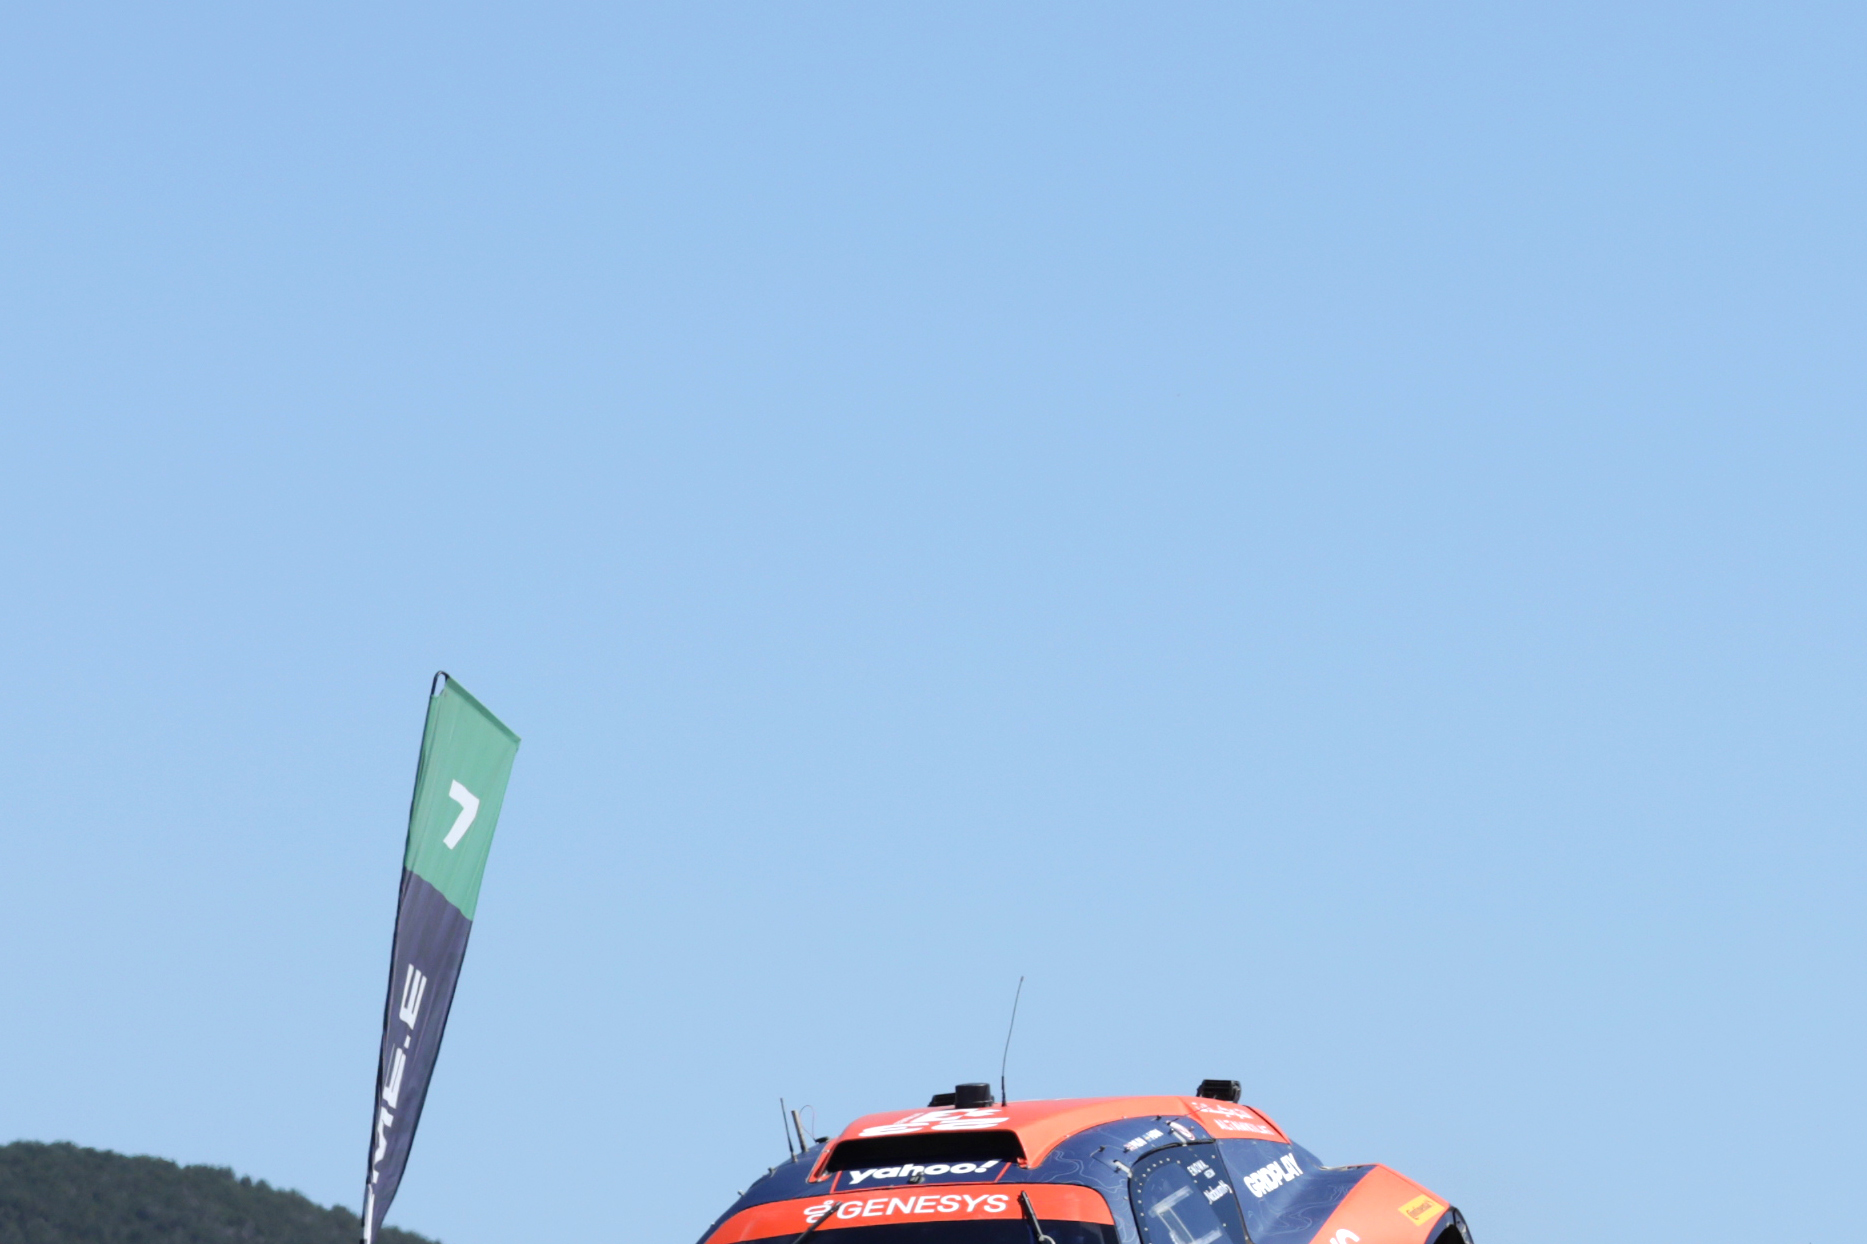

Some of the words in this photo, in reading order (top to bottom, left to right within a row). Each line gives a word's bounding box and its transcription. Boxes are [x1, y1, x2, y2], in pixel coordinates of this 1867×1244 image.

[849, 1160, 1000, 1185] yahoo!
[1243, 1153, 1303, 1198] GRIDPLAY
[836, 1194, 1010, 1220] GENESYS
